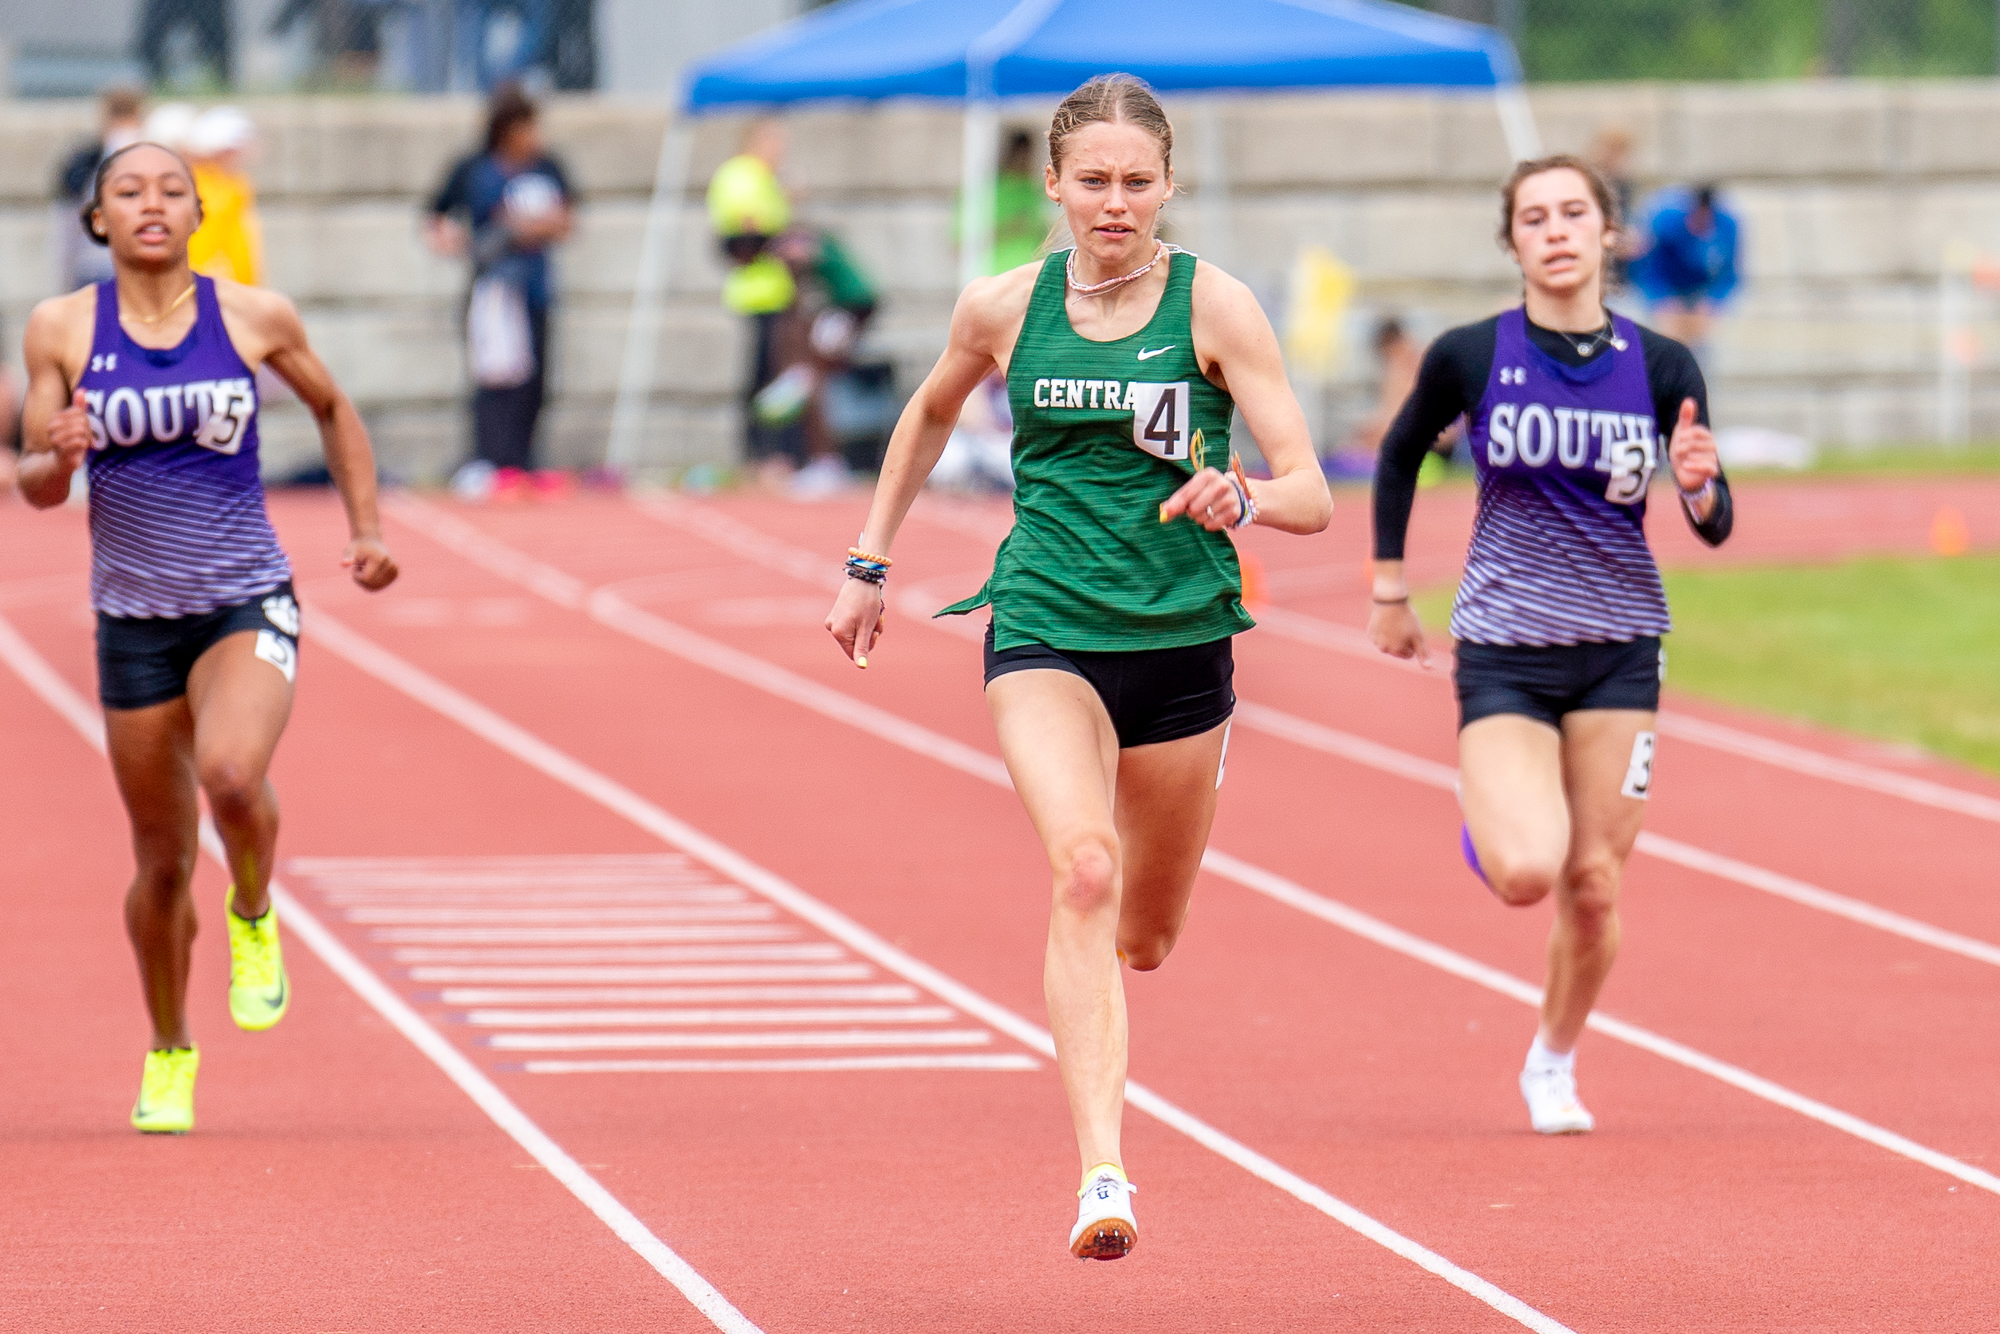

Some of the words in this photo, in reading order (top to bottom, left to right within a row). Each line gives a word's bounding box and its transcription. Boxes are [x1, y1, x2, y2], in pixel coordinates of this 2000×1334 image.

[85, 377, 253, 451] SOUT
[211, 394, 244, 447] 5
[1034, 378, 1138, 411] CENTRA
[1143, 387, 1181, 456] 4
[1618, 444, 1646, 498] 3
